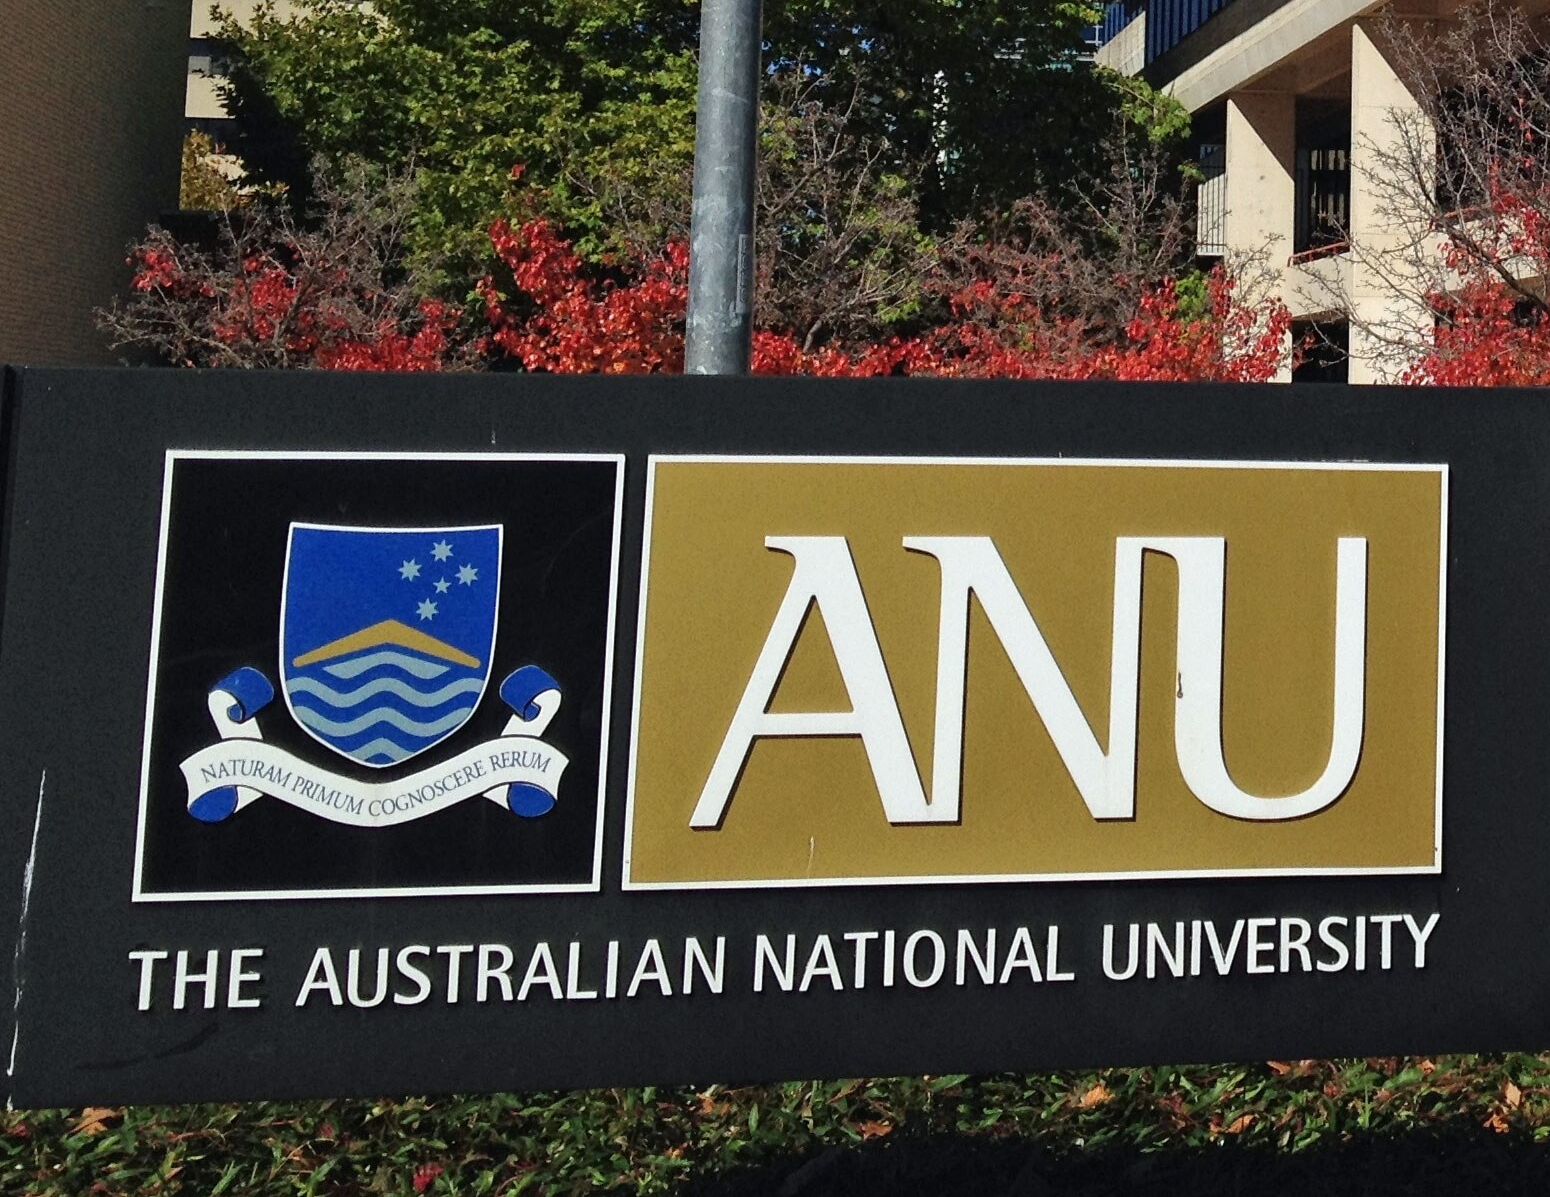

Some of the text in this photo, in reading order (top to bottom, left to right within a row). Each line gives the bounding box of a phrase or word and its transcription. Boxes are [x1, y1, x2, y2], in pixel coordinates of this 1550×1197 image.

[689, 536, 1366, 827] ANU
[201, 750, 552, 817] NATURAM PRIMUM COGNOSCERE RERUM
[128, 913, 1441, 1011] THE AUSTRALIAN NATIONAL UNIVERSITY
